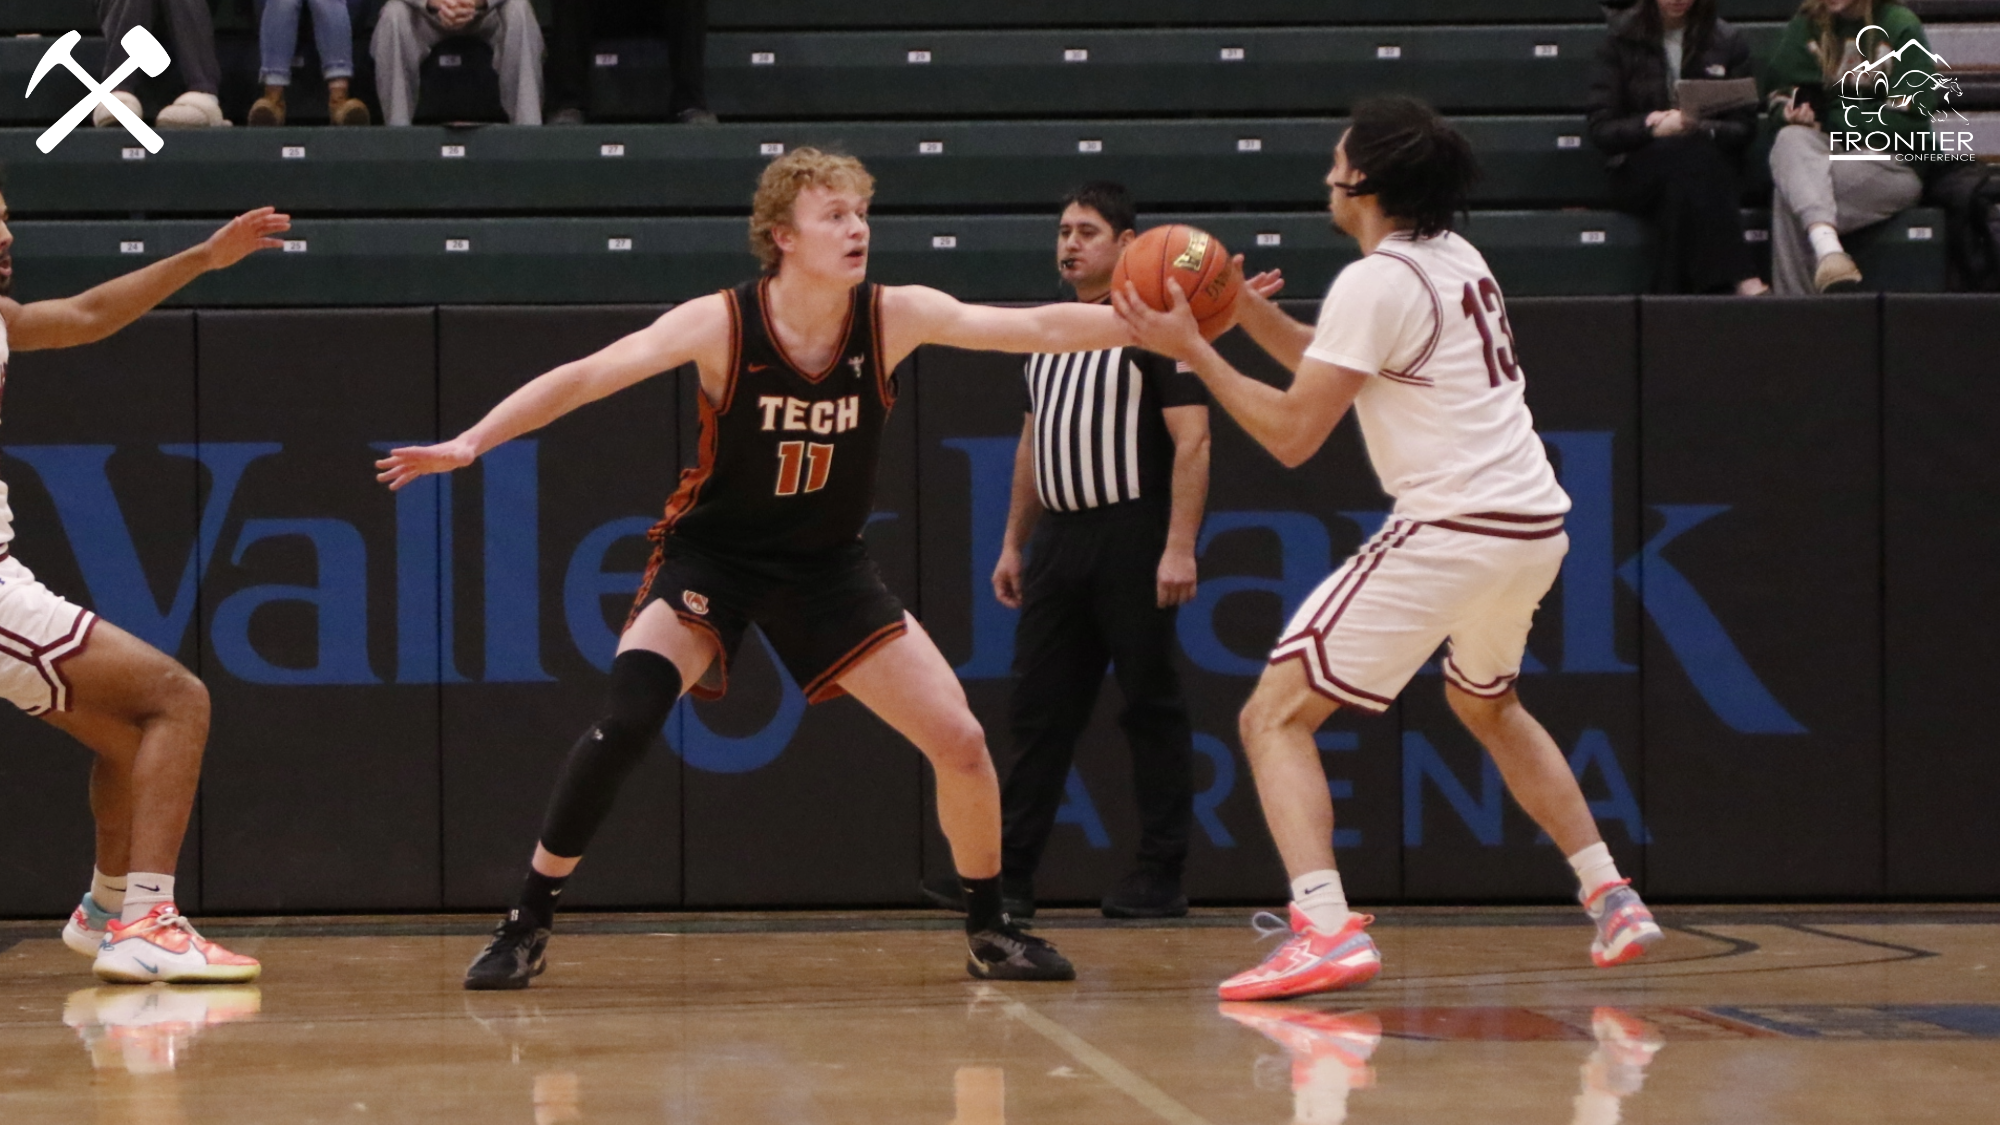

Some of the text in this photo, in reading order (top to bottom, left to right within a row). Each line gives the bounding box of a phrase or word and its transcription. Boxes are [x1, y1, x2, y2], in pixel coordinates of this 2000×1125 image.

[1461, 277, 1519, 388] 13
[757, 395, 860, 435] TECH
[774, 440, 834, 496] 11
[941, 431, 1809, 734] ak
